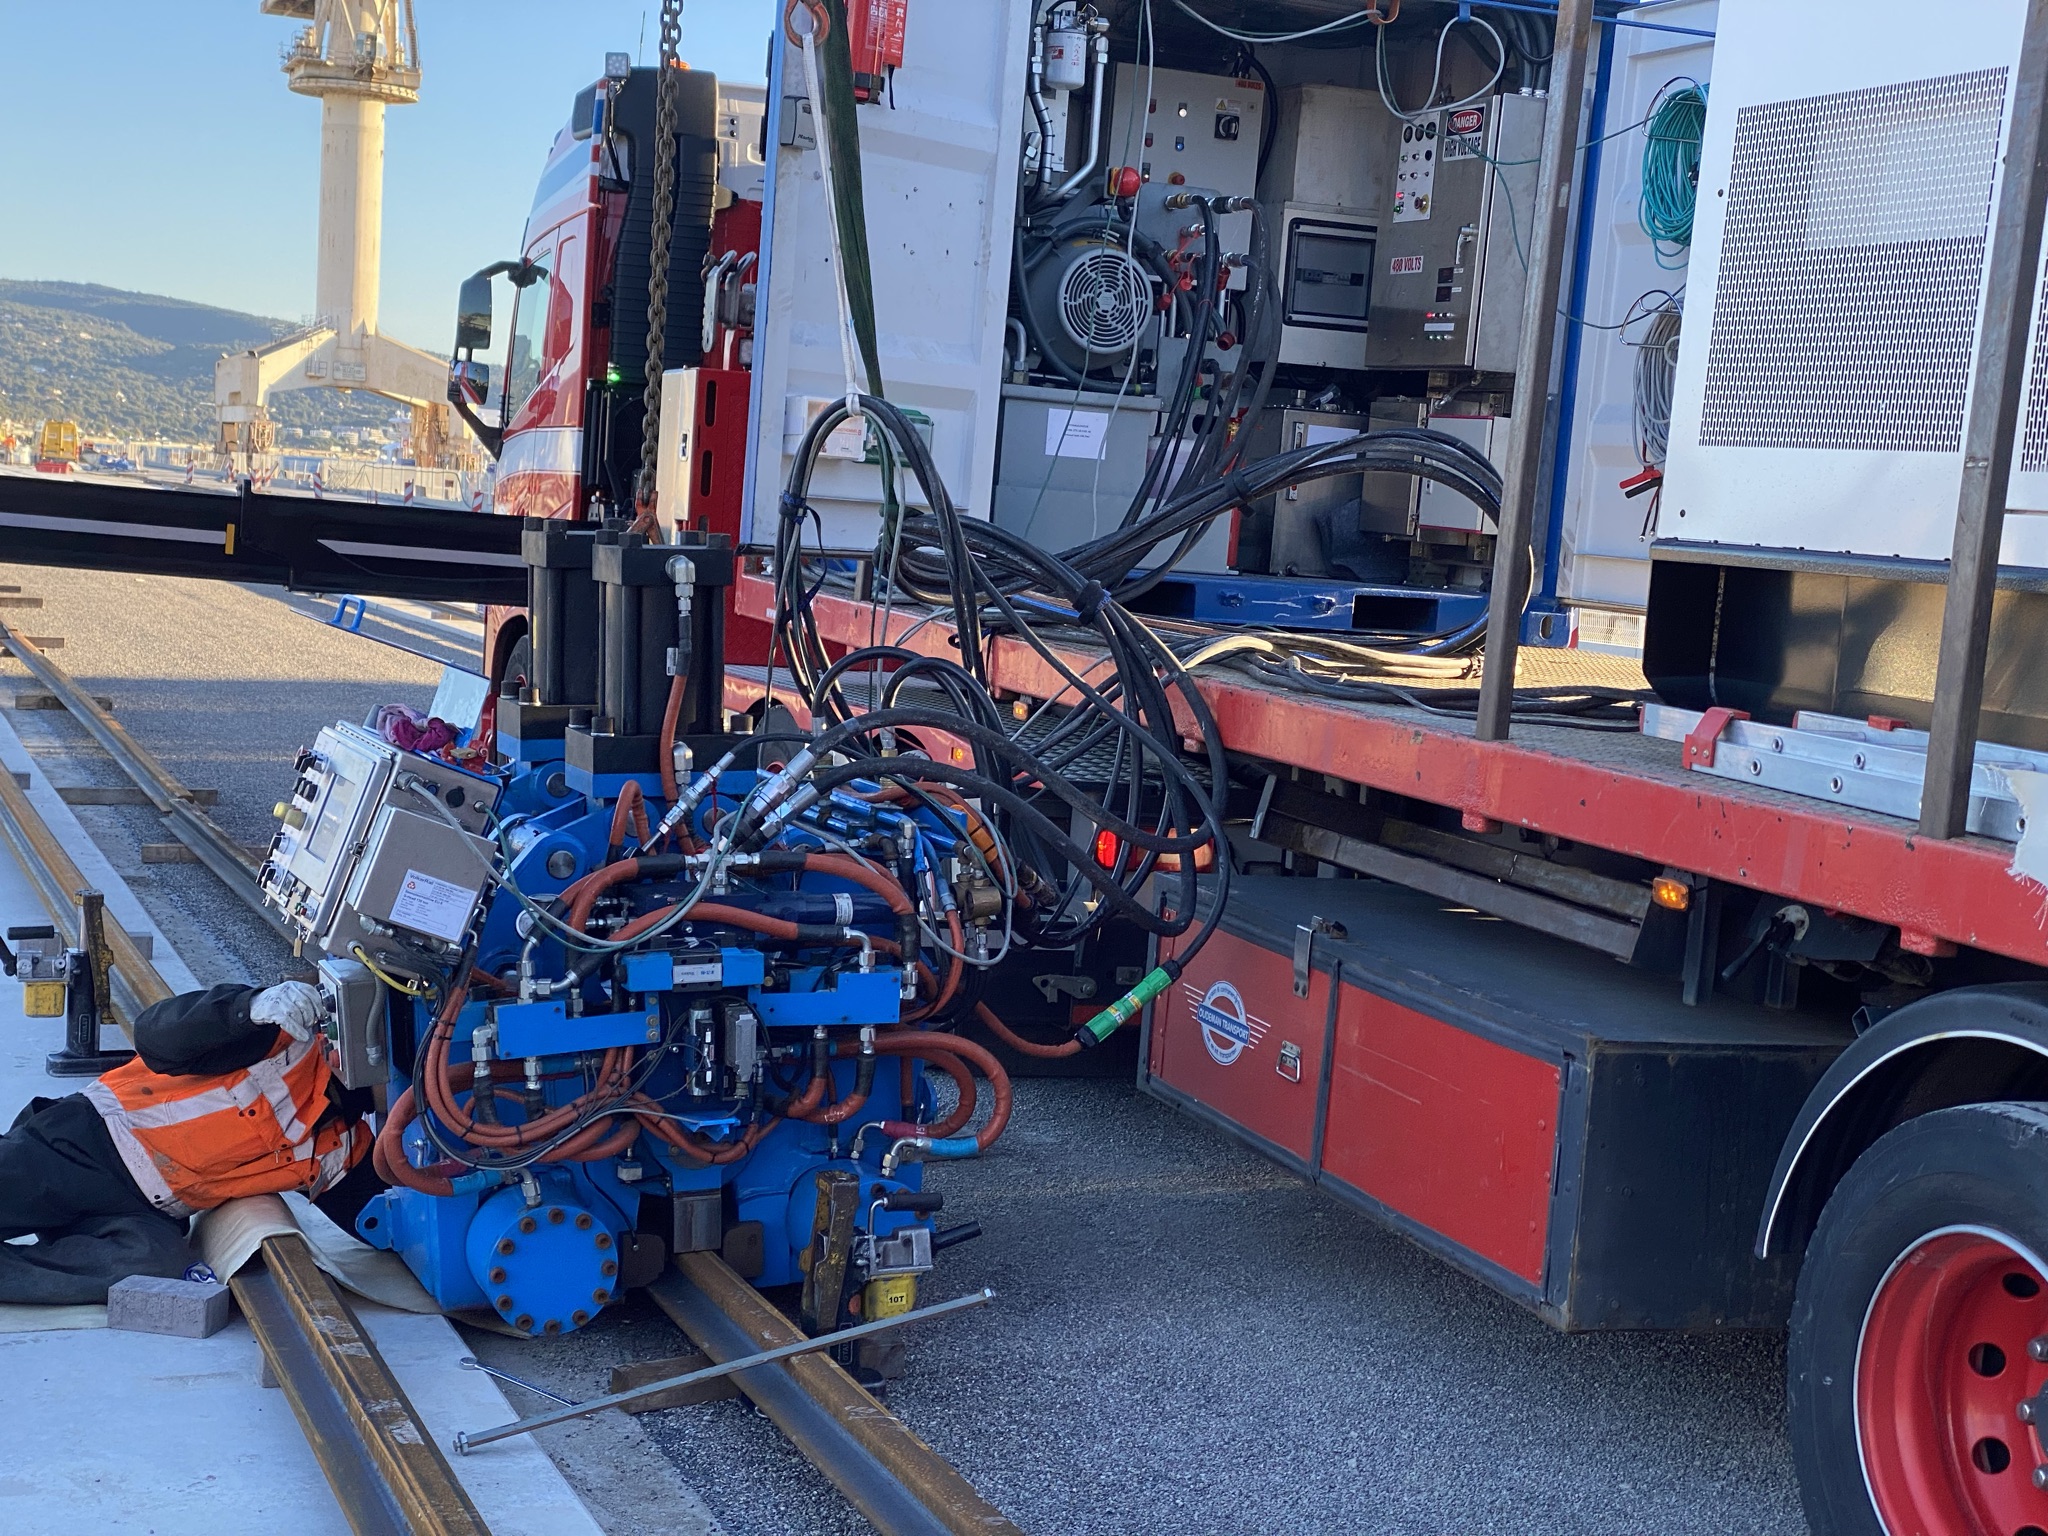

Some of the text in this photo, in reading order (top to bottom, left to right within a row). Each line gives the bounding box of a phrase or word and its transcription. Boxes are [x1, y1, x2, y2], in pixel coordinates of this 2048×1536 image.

[1451, 115, 1478, 128] DANGER
[1392, 256, 1422, 272] 480 VOLTS
[1222, 1020, 1248, 1040] TRANSPORT
